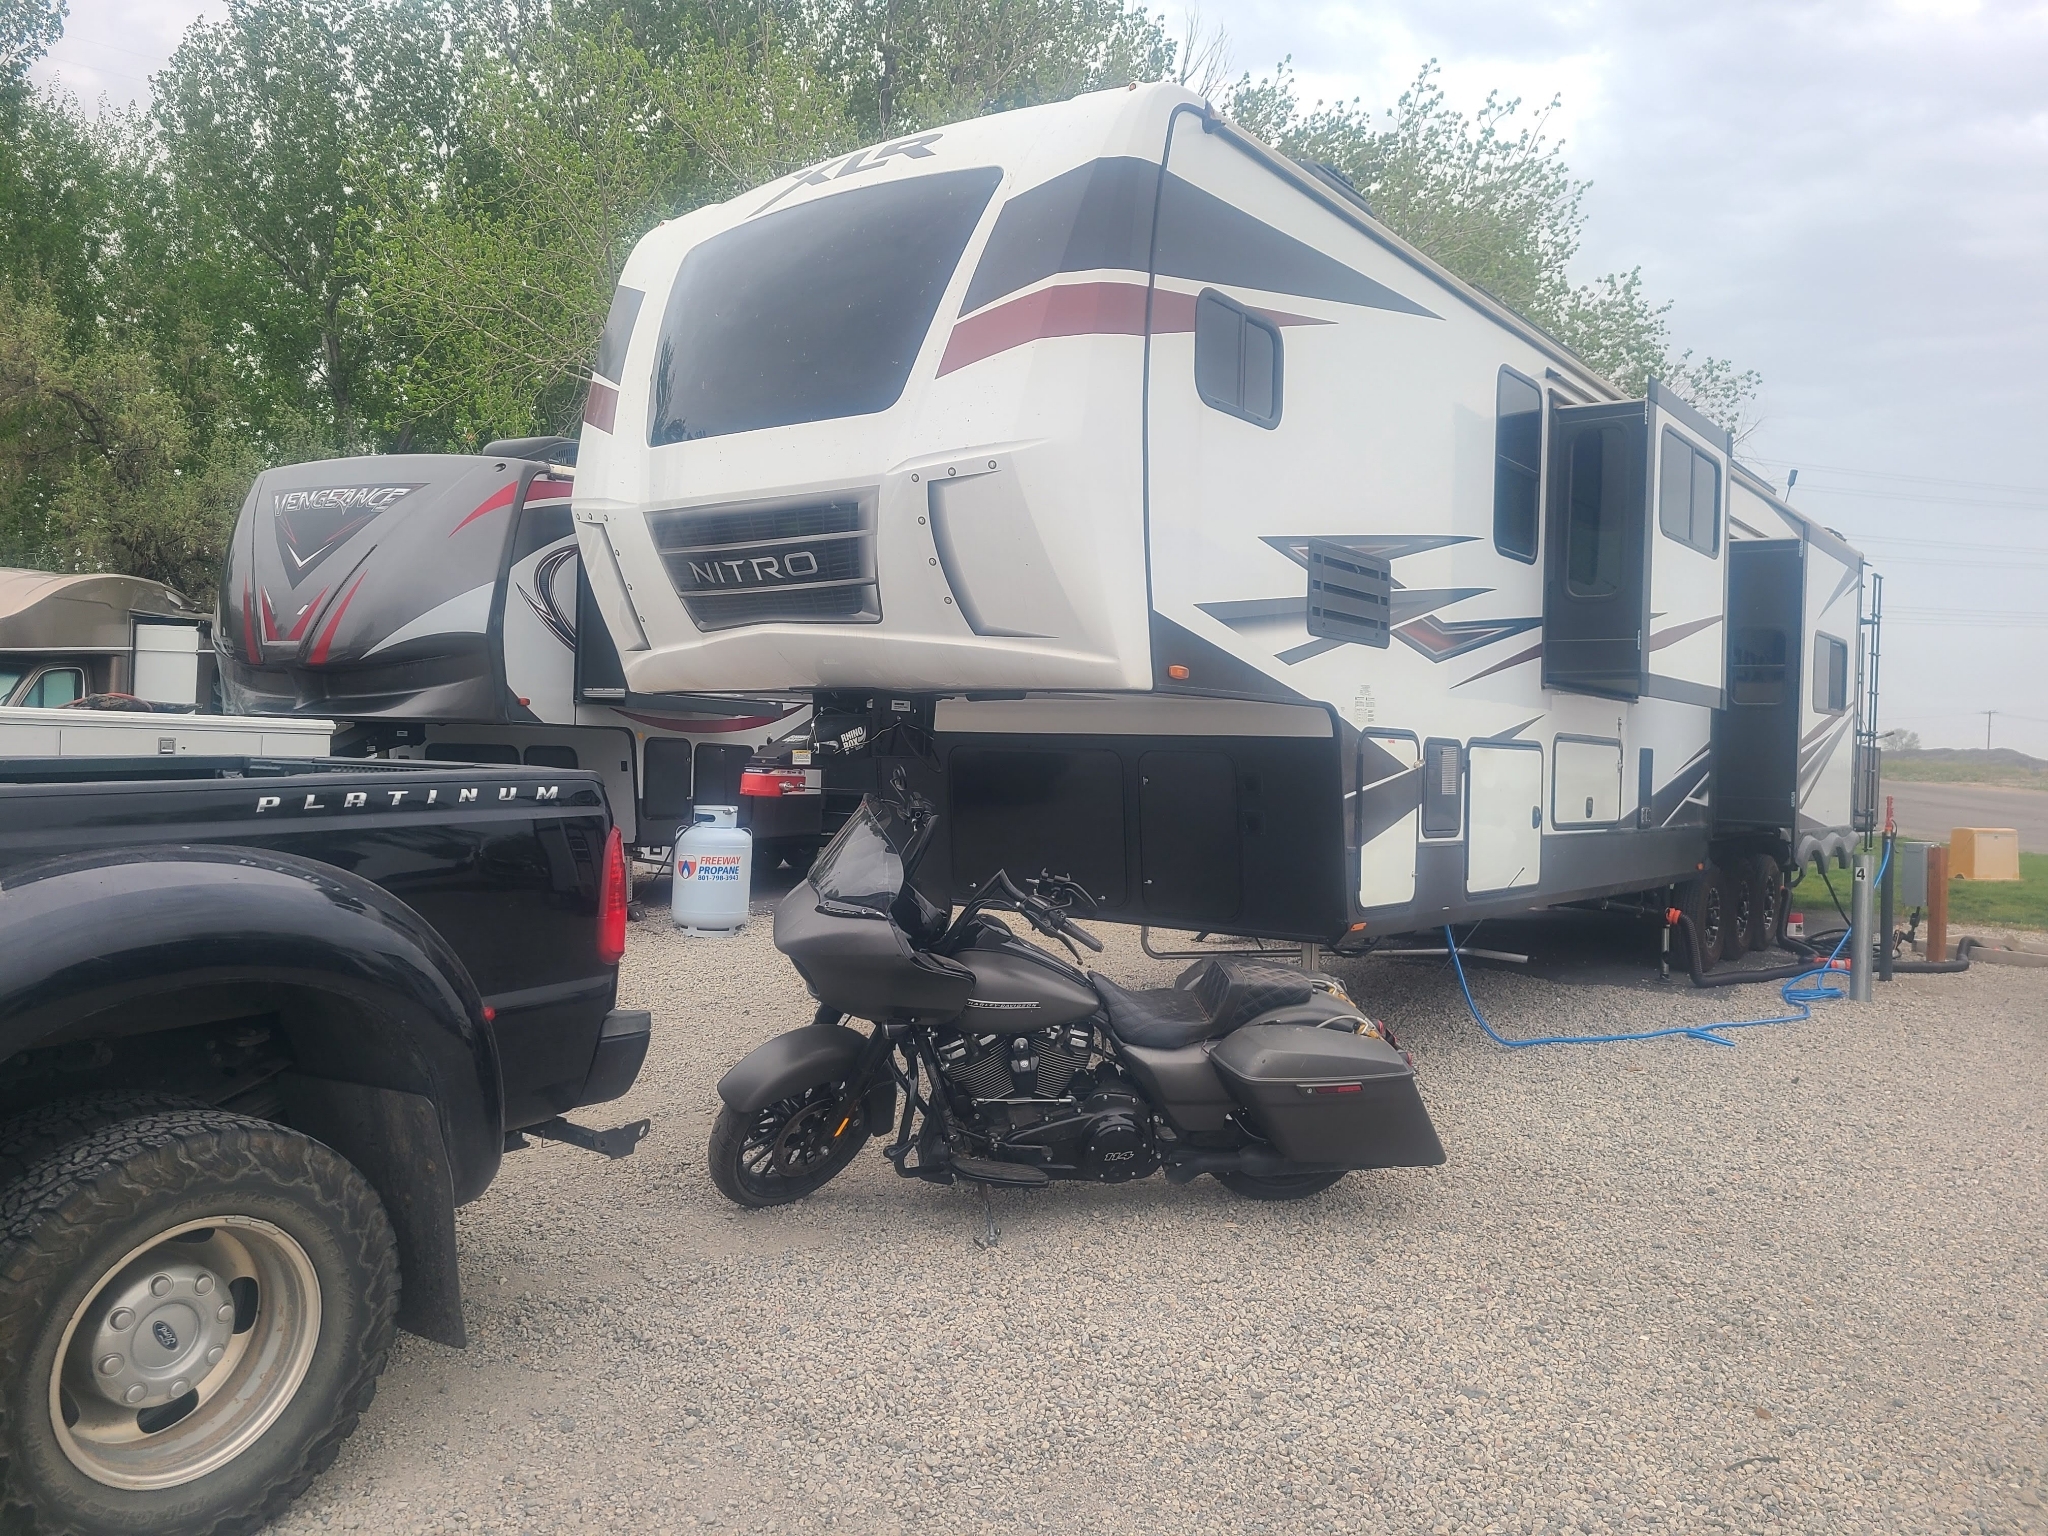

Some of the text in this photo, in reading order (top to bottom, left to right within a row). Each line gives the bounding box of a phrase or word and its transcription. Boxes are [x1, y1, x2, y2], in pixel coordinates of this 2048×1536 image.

[744, 132, 944, 220] XLR
[274, 487, 412, 517] VENGEANCE
[687, 551, 819, 584] NITRO
[840, 726, 865, 743] RHINO
[843, 737, 860, 749] BOX
[256, 785, 559, 813] PLATINUM
[700, 856, 741, 865] FREEWAY
[698, 866, 740, 875] PROPANE
[1856, 867, 1866, 881] 4
[1104, 1150, 1135, 1161] 114
